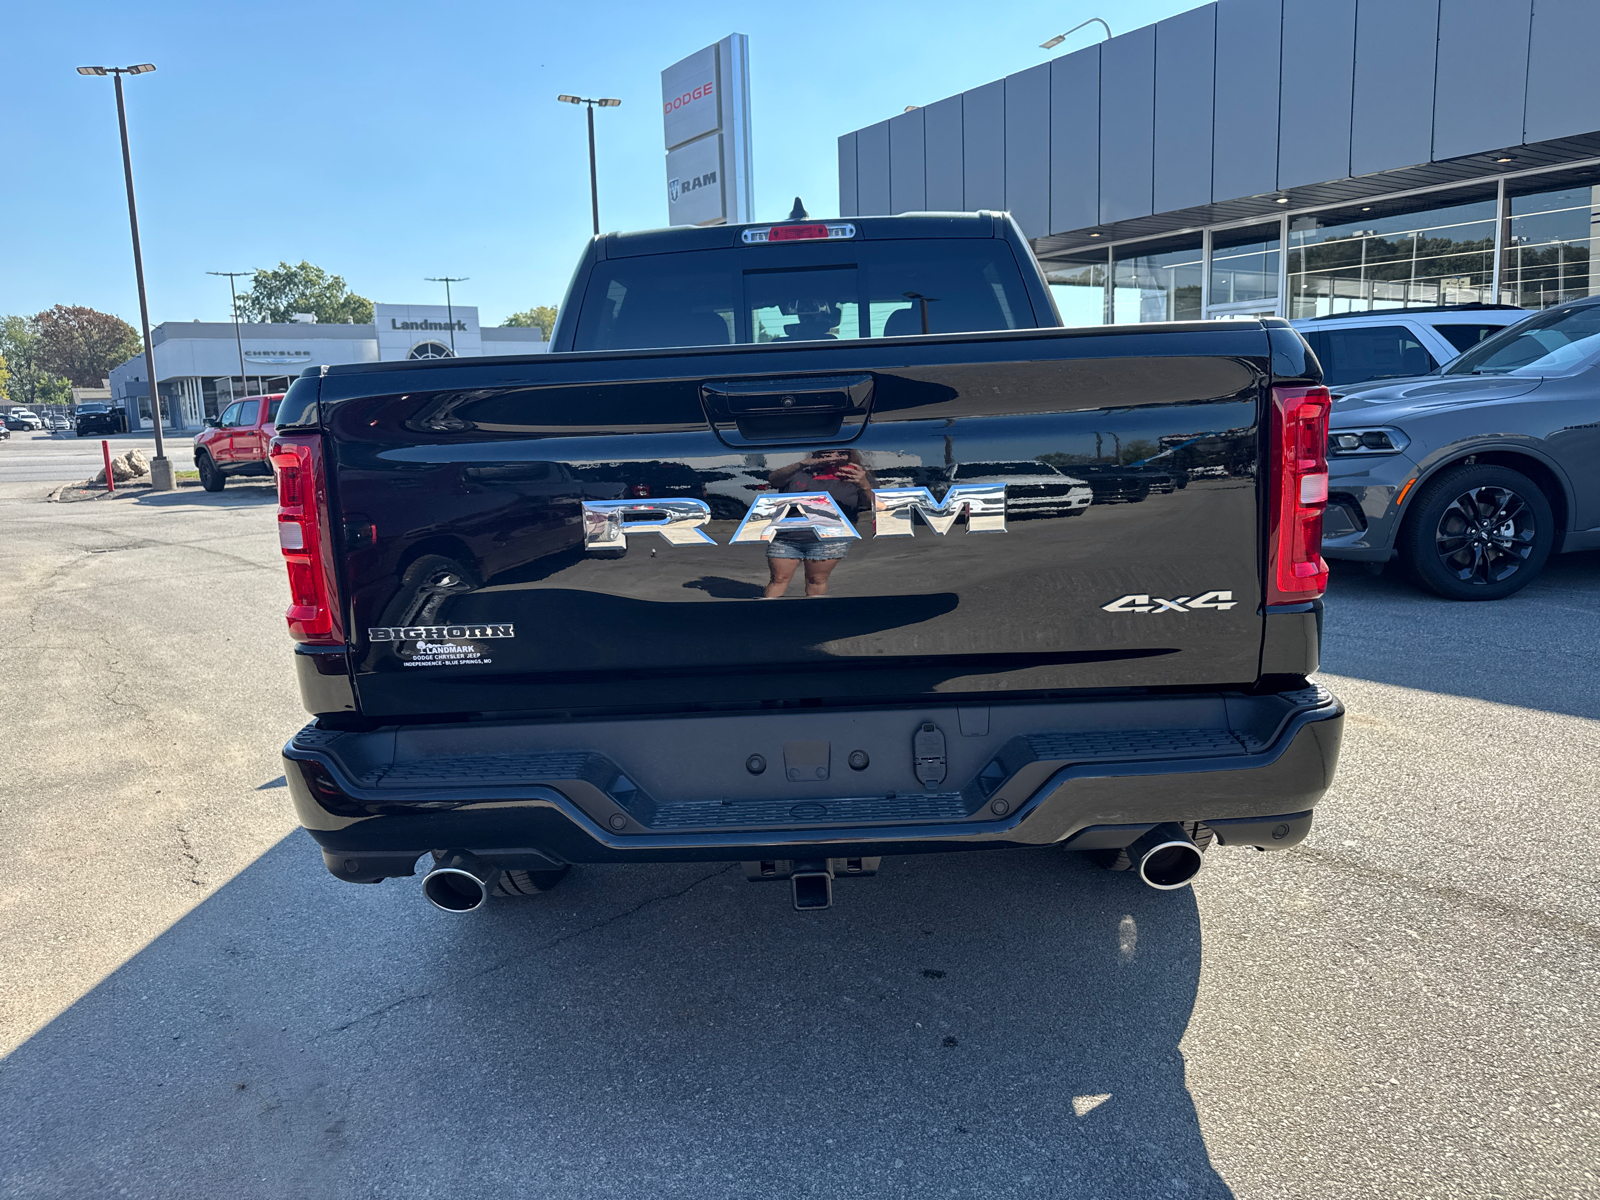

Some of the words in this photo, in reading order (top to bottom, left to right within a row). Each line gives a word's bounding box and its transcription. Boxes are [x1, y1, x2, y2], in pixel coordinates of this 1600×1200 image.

[664, 82, 713, 115] DODGE
[681, 171, 717, 194] RAM
[391, 318, 467, 331] Landmark
[581, 483, 1008, 551] RAM
[426, 645, 475, 654] LANDMARK
